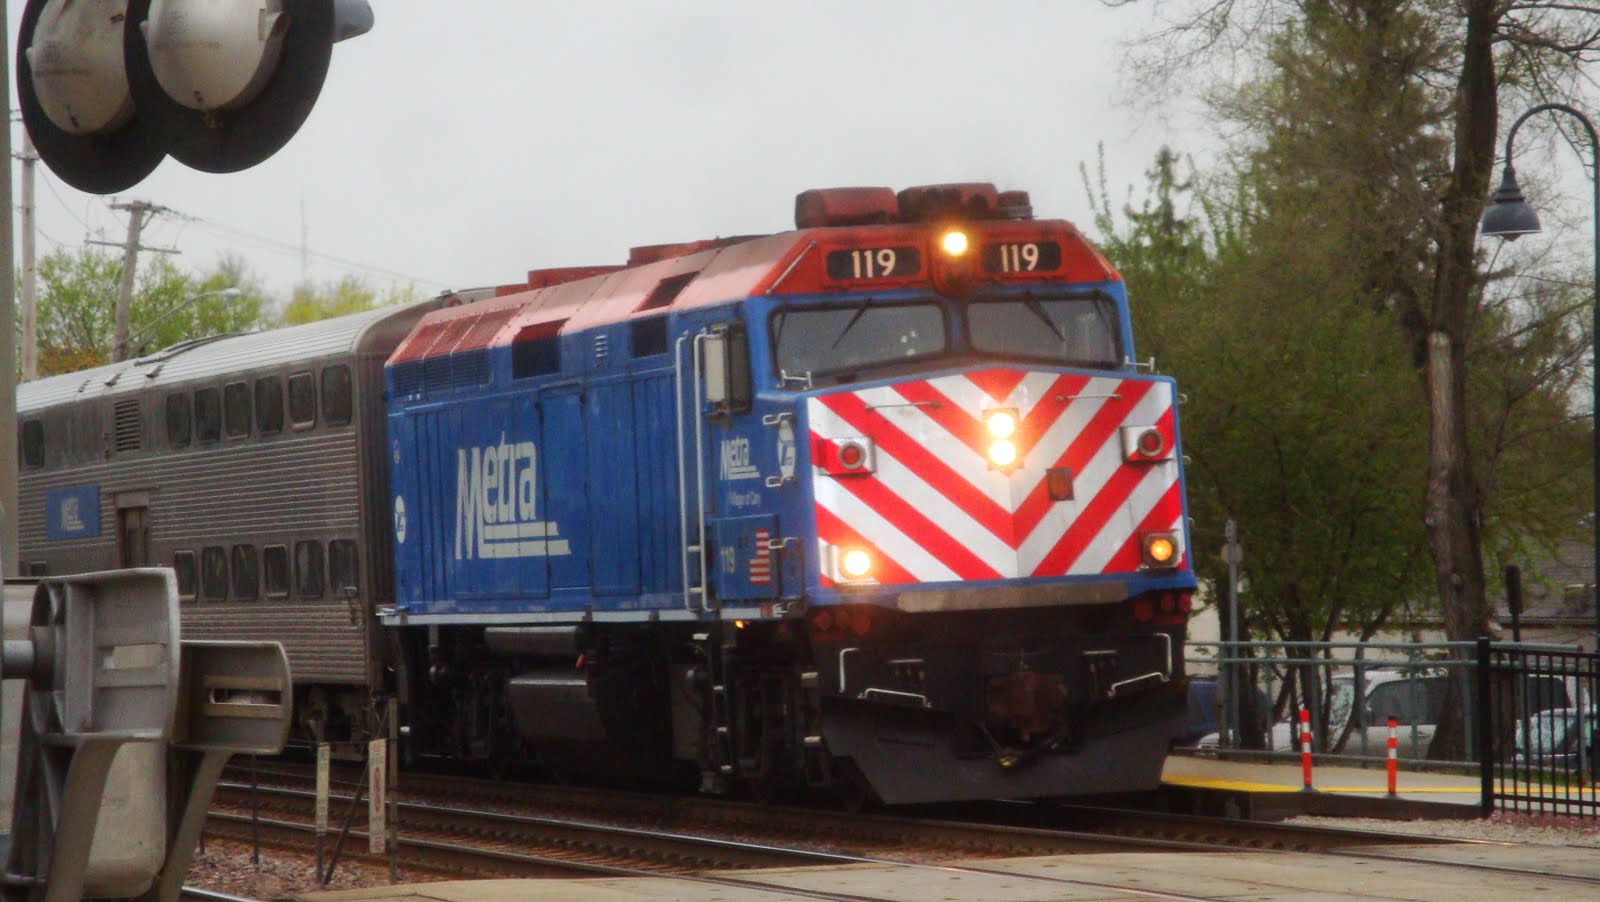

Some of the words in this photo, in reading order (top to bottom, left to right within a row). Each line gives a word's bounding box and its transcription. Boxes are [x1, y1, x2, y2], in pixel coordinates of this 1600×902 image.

[851, 248, 896, 278] 119
[1000, 243, 1039, 272] 119
[720, 436, 750, 480] Metra
[455, 431, 538, 559] Metra
